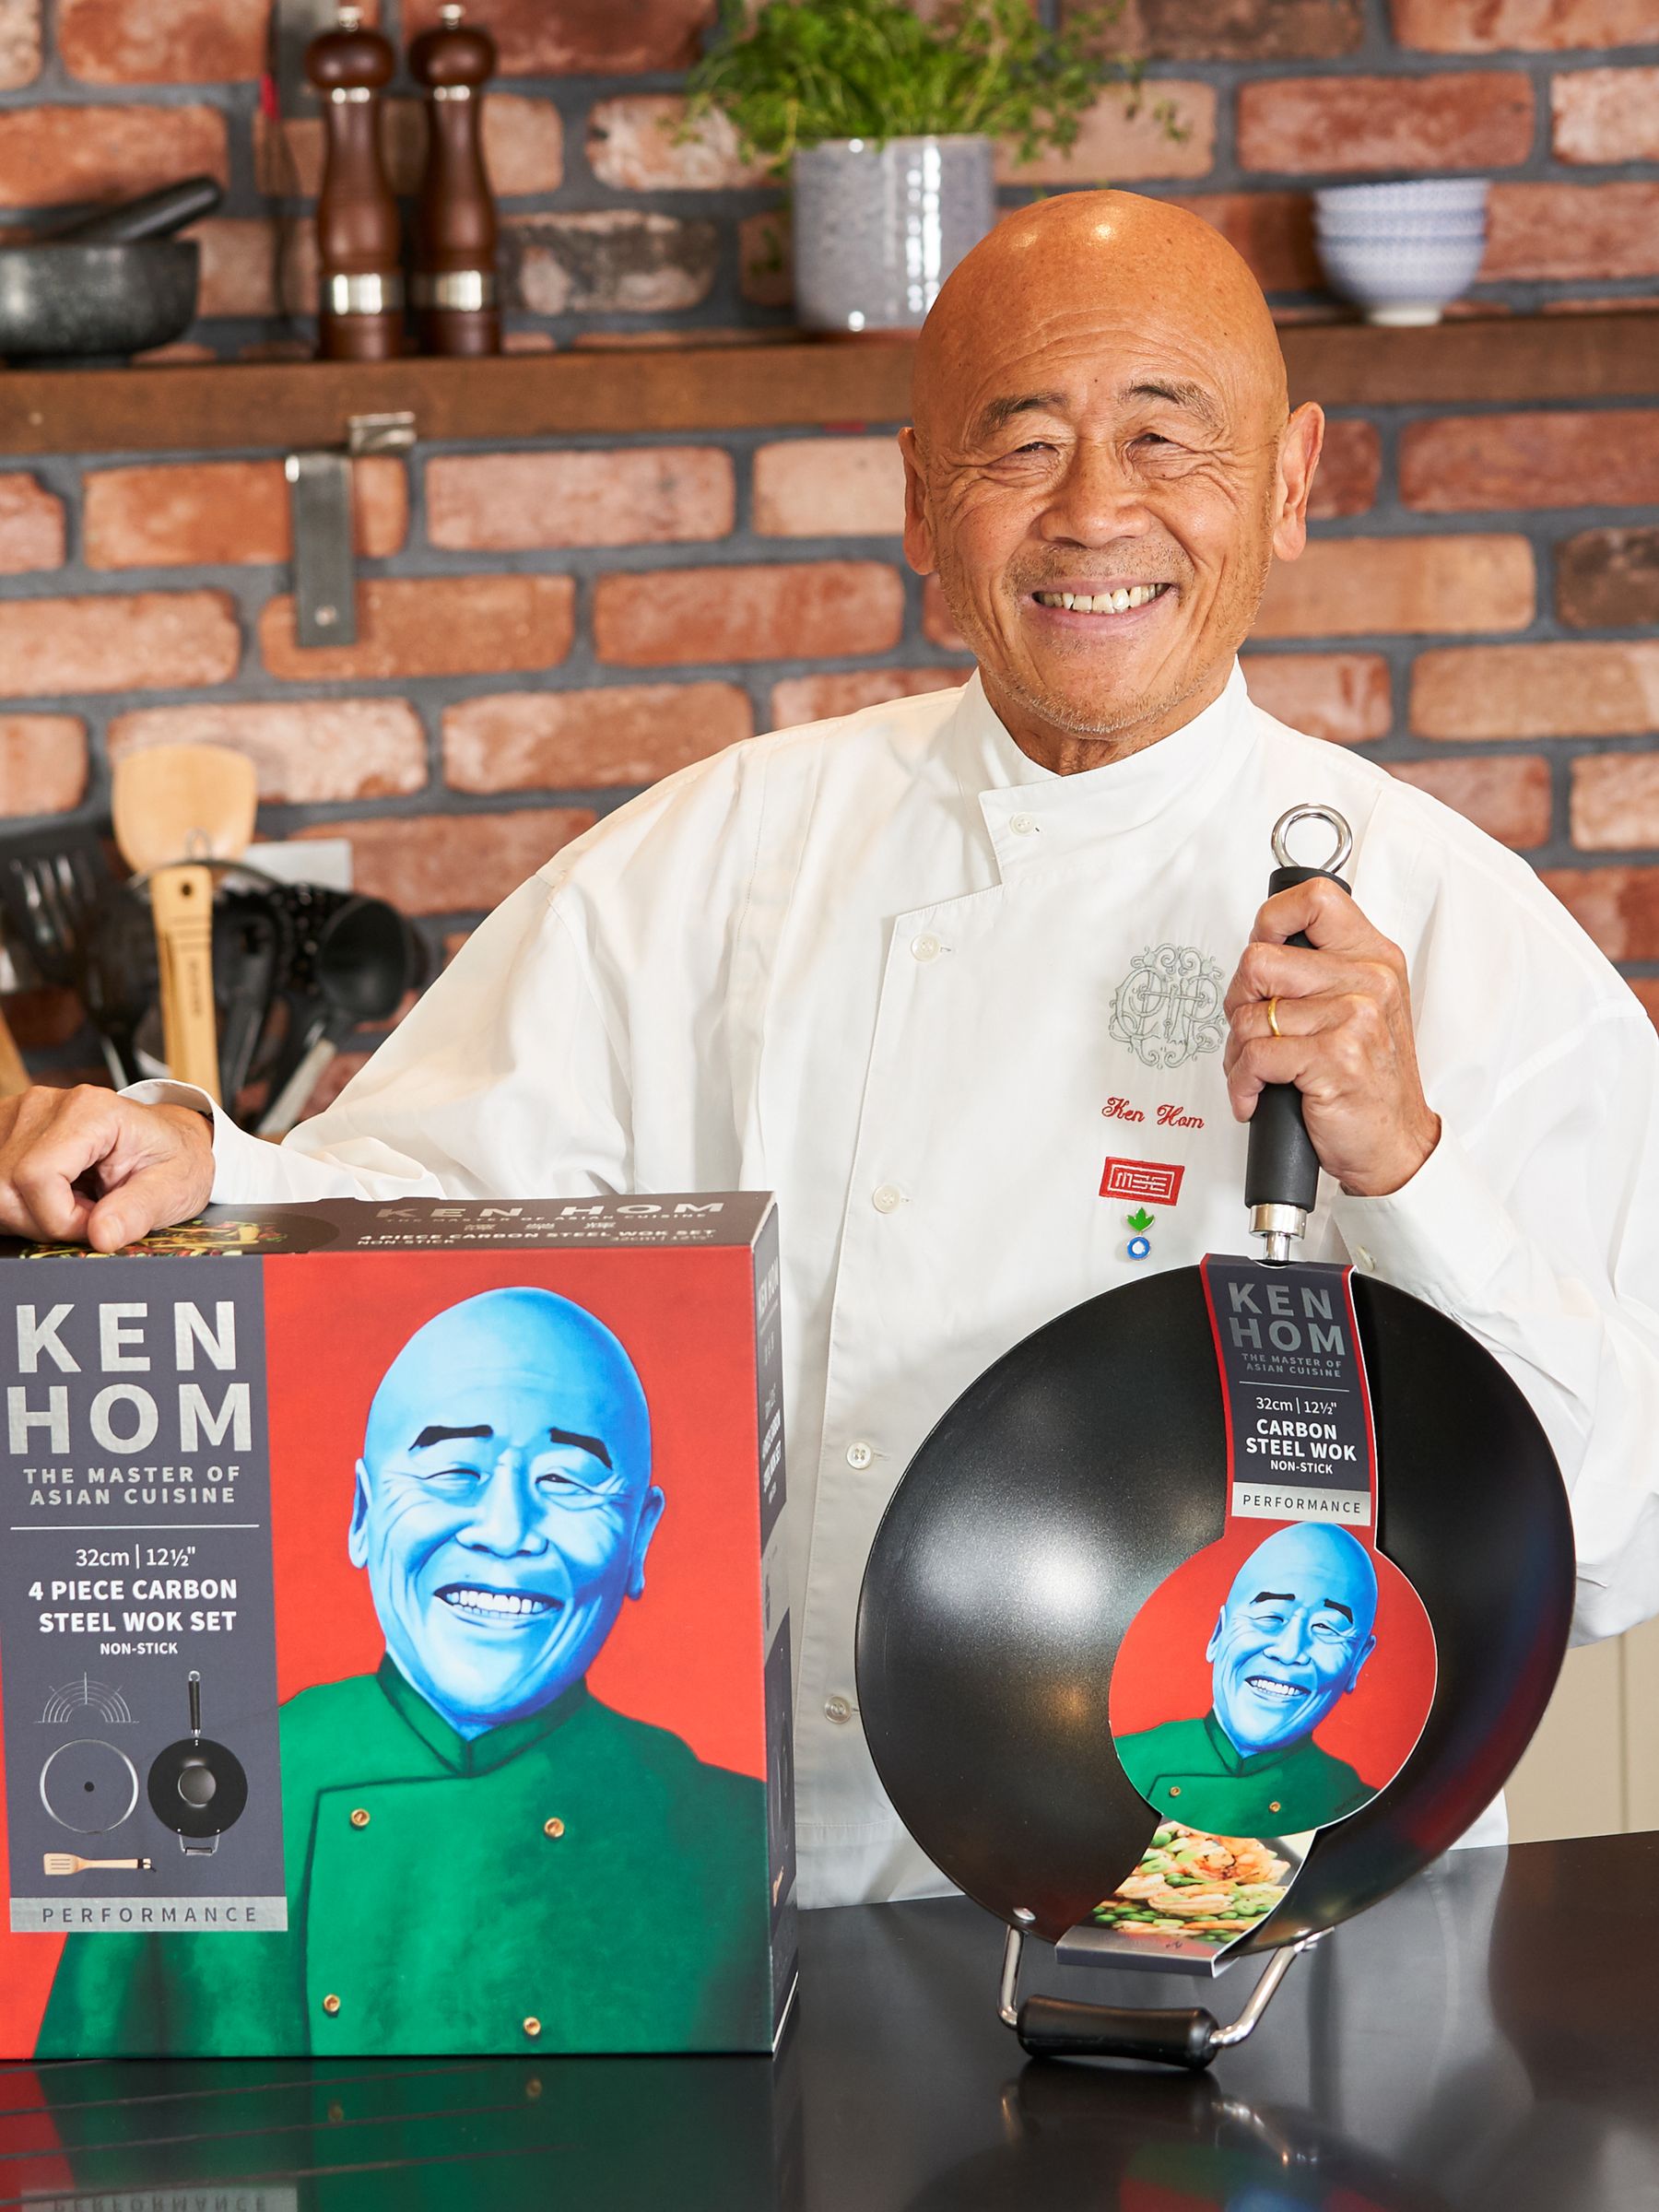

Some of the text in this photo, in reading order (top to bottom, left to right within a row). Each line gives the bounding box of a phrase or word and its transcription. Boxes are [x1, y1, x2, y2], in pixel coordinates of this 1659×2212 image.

[1101, 1097, 1205, 1128] Ken Hom
[376, 1203, 724, 1218] KEN HOM
[1228, 1282, 1334, 1320] KEN
[17, 1300, 237, 1373] KEN
[1230, 1316, 1346, 1356] HOM
[1241, 1353, 1343, 1368] THE MASTER OF
[1246, 1362, 1341, 1378] ASIAN CUISINE
[1255, 1396, 1293, 1411] 32cm
[7, 1382, 252, 1454] HOM
[1256, 1418, 1337, 1441] CARBON
[1246, 1437, 1357, 1462] STEEL WOK
[23, 1465, 241, 1484] THE MASTER OF
[1270, 1459, 1334, 1475] NON-STICK
[30, 1487, 235, 1505] ASIAN CUISINE
[1242, 1494, 1361, 1513] PERFORMANCE
[76, 1548, 130, 1567] 32cm
[28, 1579, 238, 1601] 4 PIECE CARBON
[39, 1611, 237, 1633] STEEL WOK SET
[100, 1641, 179, 1655] NON-STICK
[42, 1906, 257, 1924] PERFORMANCE
